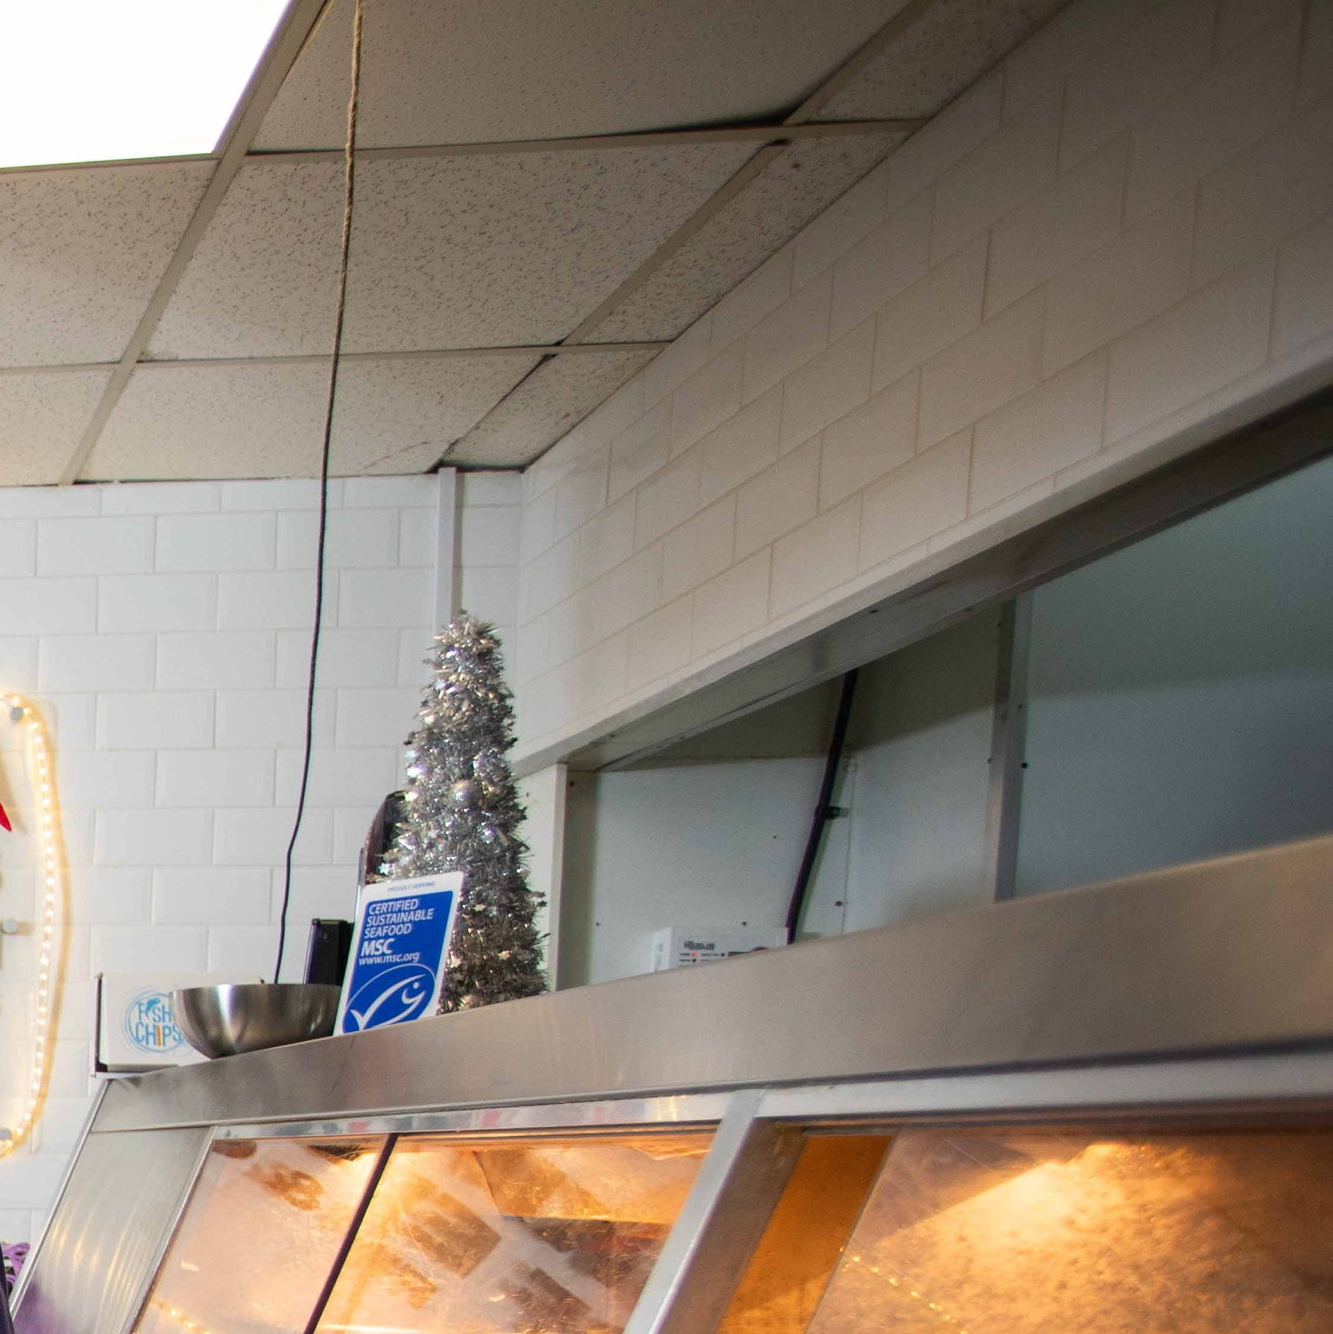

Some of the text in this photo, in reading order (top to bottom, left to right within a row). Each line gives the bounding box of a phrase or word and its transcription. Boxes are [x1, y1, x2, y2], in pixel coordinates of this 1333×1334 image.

[369, 899, 420, 915] CERTIFIED
[366, 908, 434, 927] SUSTAINABLE
[364, 923, 412, 939] SEAFOOD
[361, 938, 395, 956] MSC
[359, 952, 420, 966] www.msc.org
[134, 1021, 184, 1046] CHIPS
